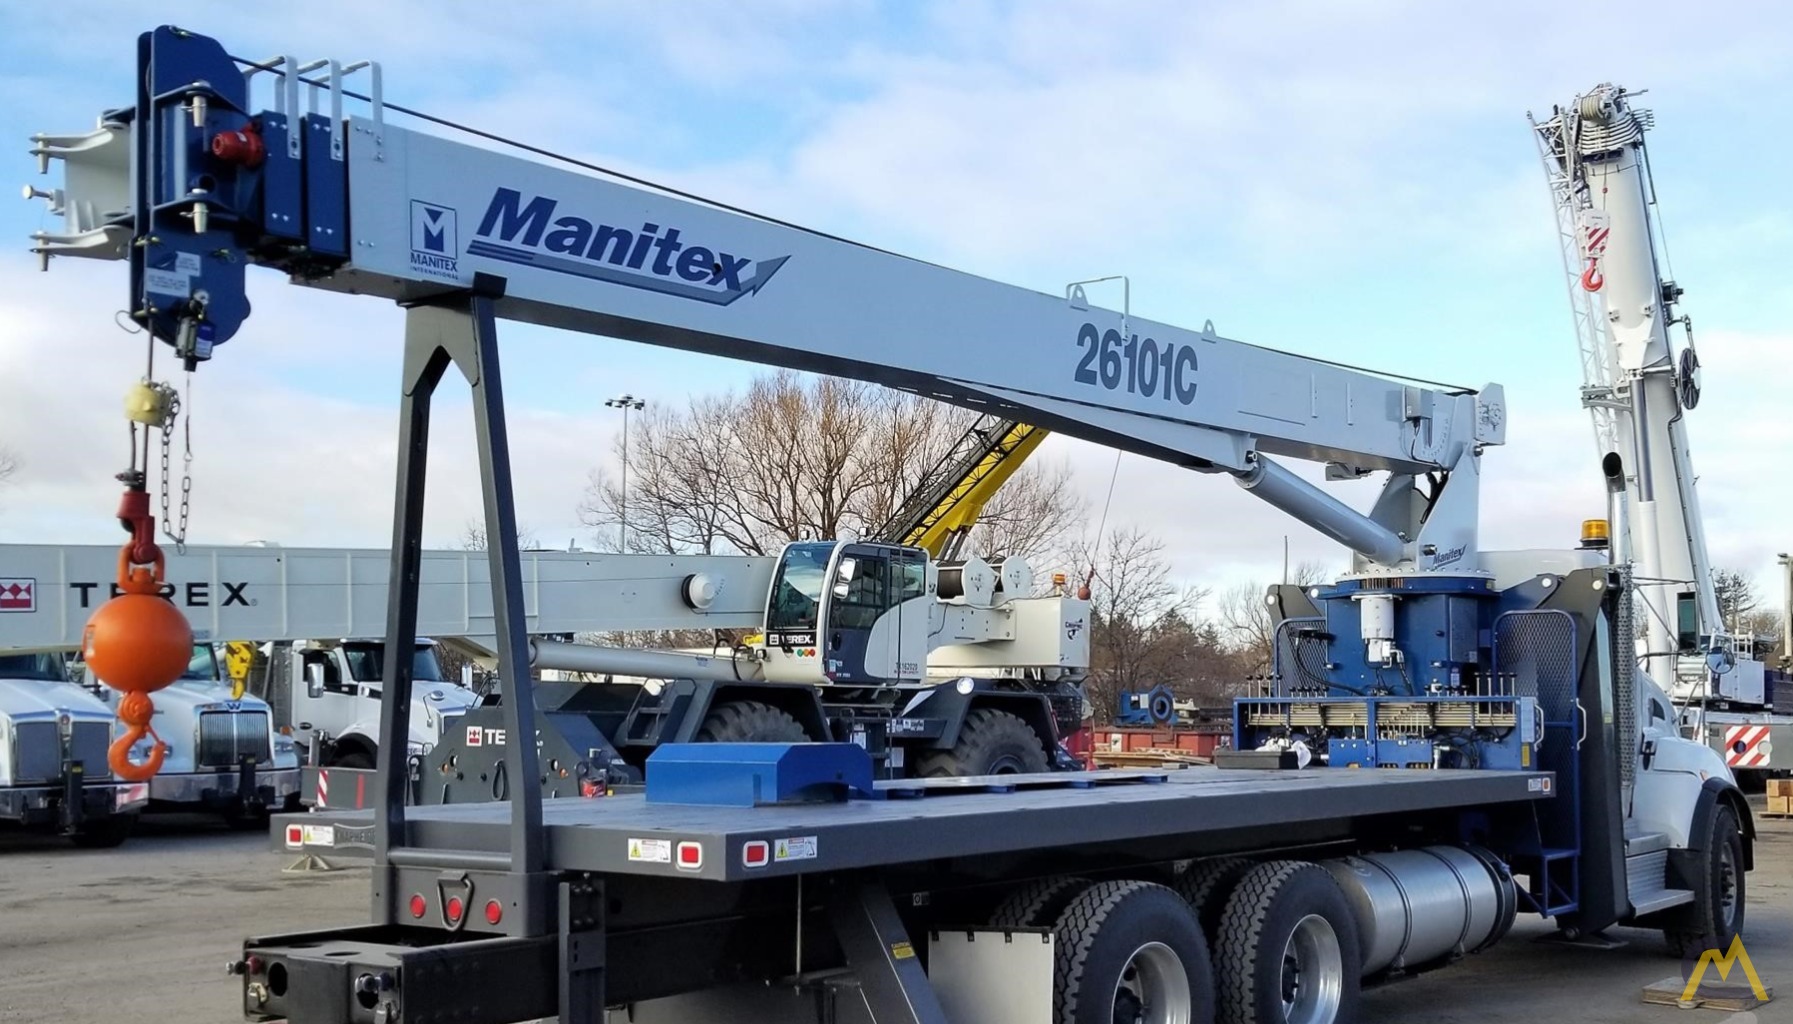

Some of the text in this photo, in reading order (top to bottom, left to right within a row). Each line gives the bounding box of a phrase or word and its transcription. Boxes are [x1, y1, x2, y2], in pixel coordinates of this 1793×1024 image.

[410, 252, 458, 272] MANITEX
[476, 187, 752, 292] Manitex
[1074, 322, 1198, 405] 26101C
